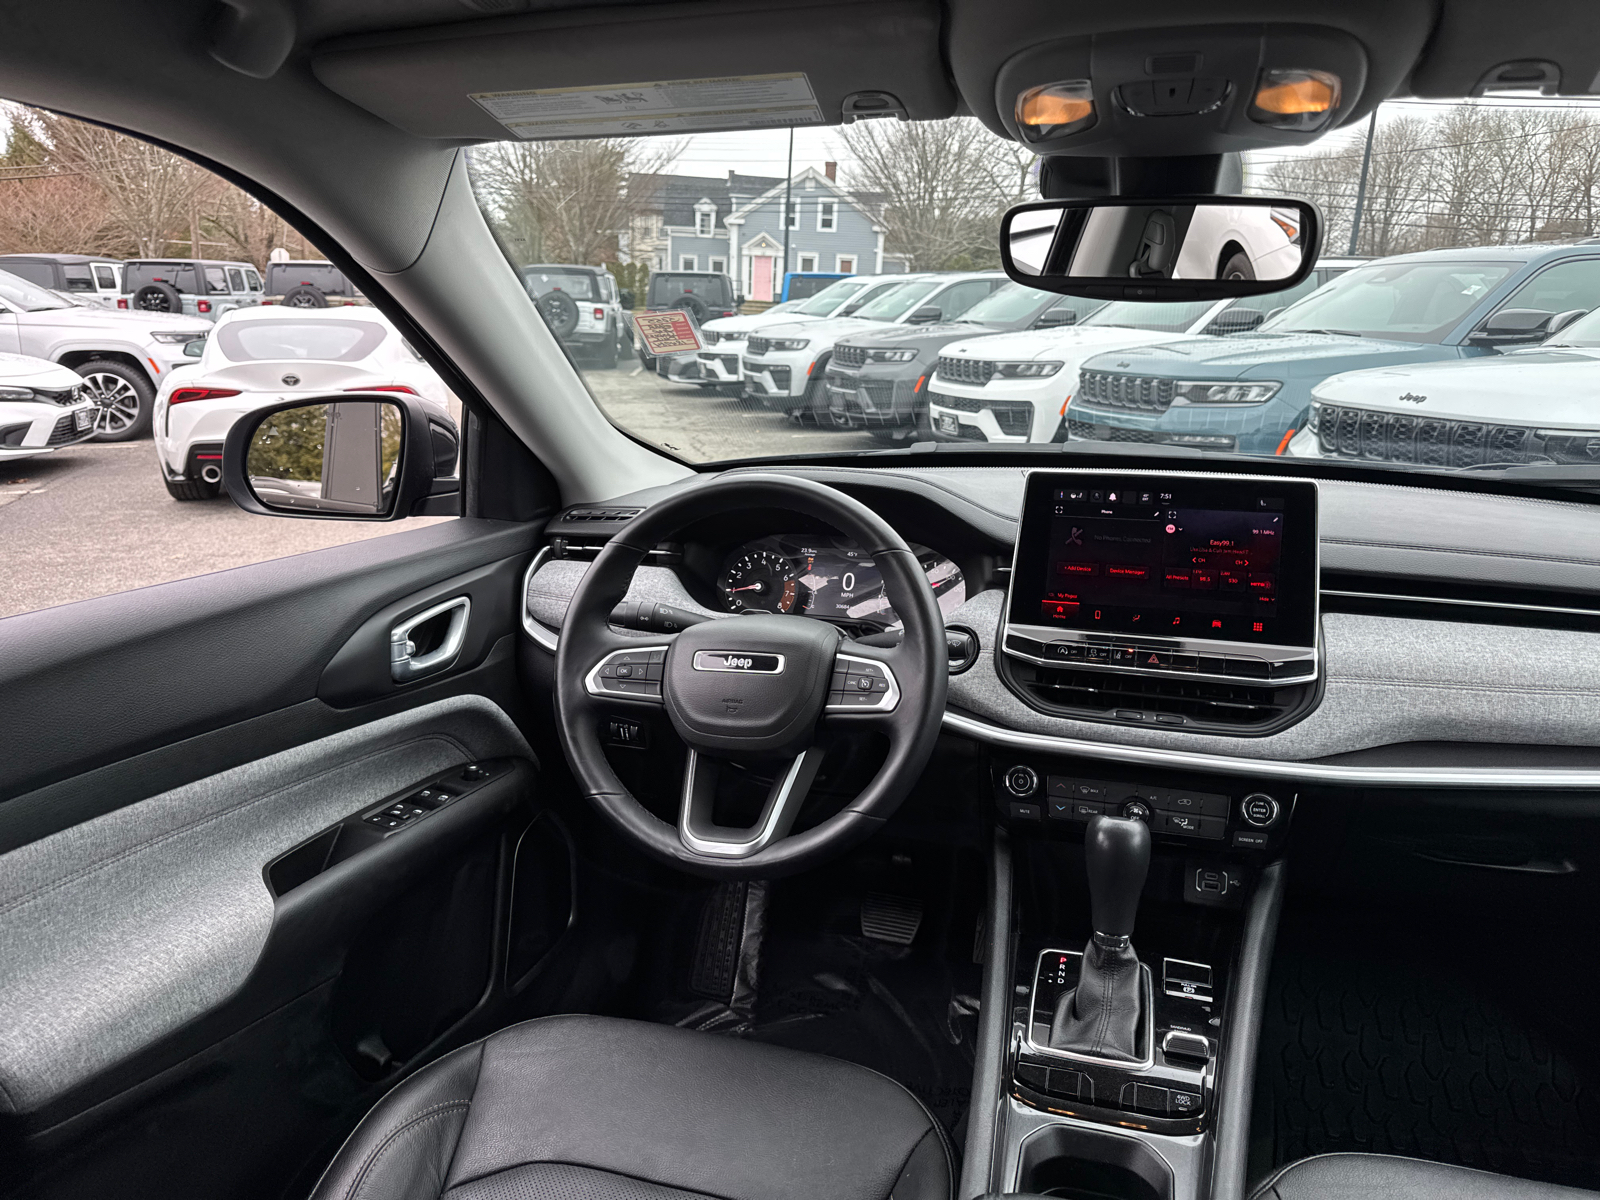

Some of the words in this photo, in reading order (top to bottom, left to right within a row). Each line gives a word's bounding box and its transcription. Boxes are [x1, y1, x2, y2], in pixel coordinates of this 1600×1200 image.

[1398, 392, 1428, 404] Jeep
[842, 572, 855, 591] 0
[723, 655, 752, 669] Jeep
